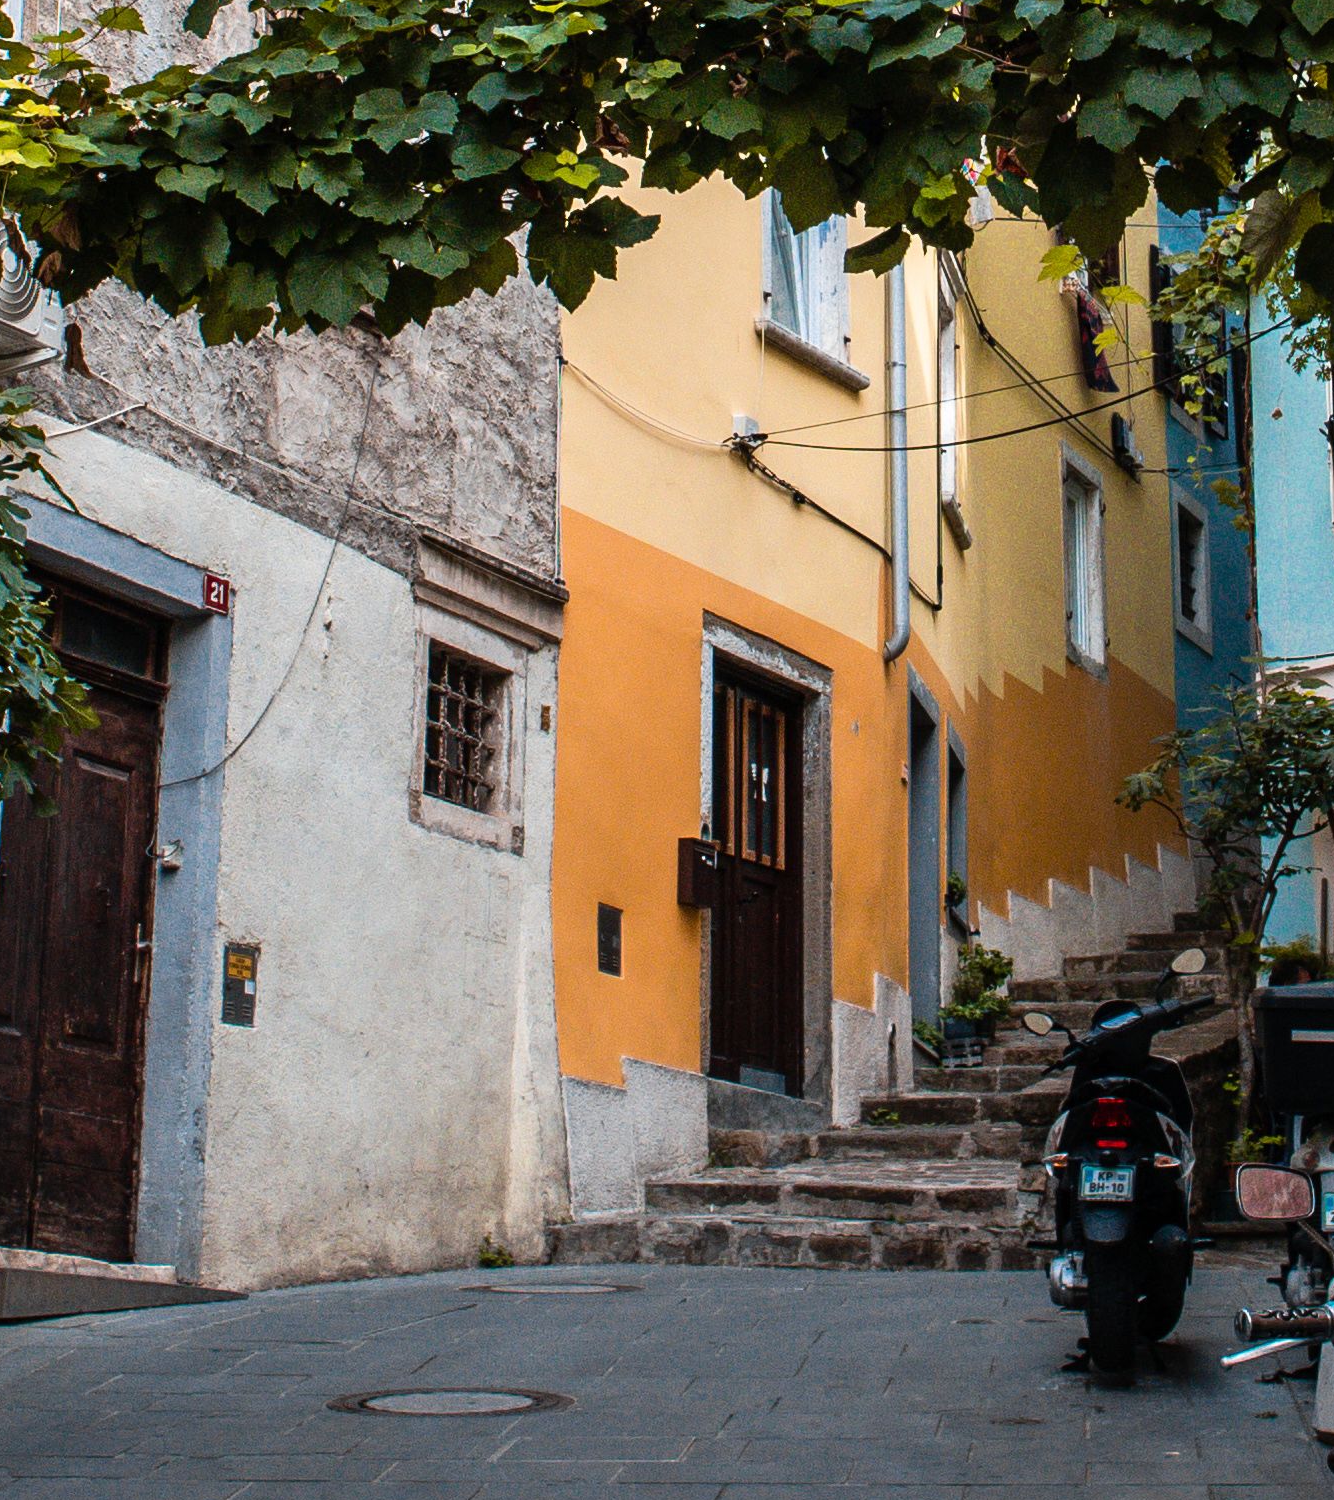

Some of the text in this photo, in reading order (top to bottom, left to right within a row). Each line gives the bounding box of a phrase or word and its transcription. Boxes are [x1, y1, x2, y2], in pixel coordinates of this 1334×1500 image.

[210, 581, 224, 604] 21
[1098, 1171, 1114, 1181] KP
[1089, 1182, 1124, 1193] BH-10
